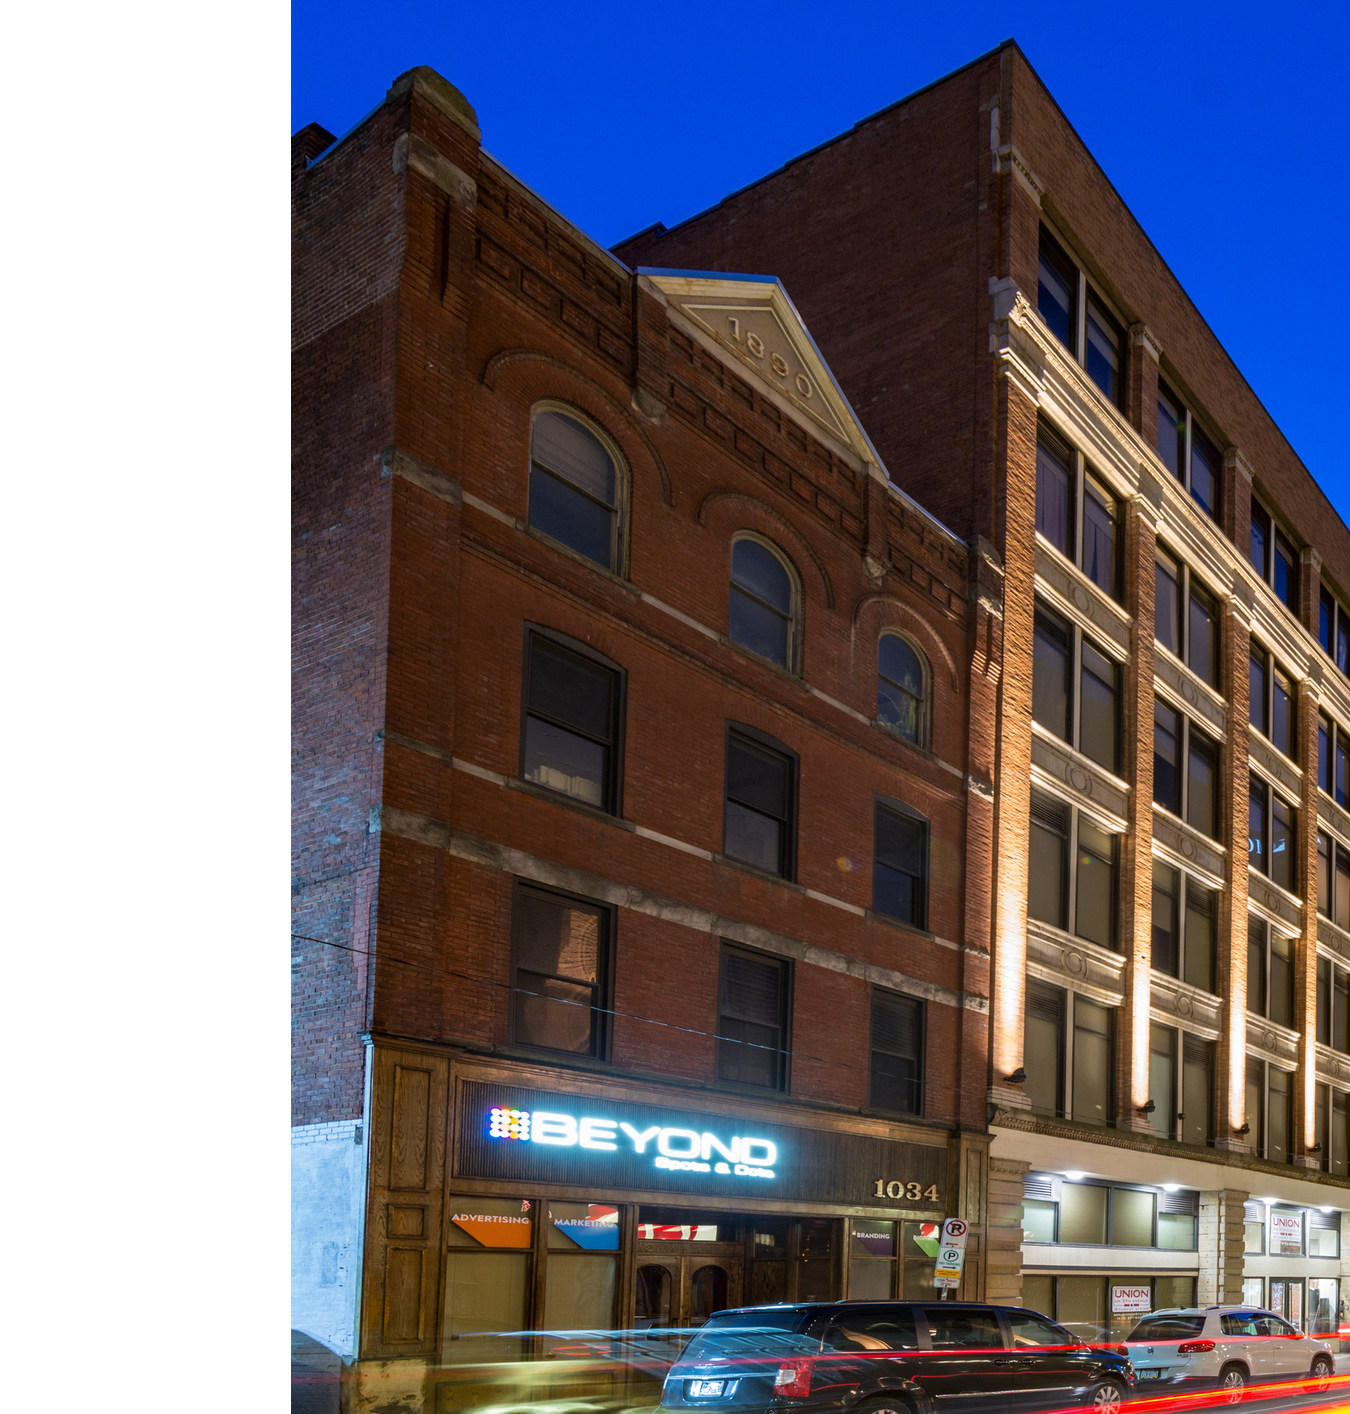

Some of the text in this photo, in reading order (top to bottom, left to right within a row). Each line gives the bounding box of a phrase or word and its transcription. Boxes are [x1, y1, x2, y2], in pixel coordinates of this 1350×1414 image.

[728, 316, 813, 398] 1890
[530, 1110, 778, 1167] BEYOND
[655, 1156, 775, 1178] Spots & Dots
[873, 1179, 939, 1201] 1034
[451, 1213, 530, 1224] ADVERTISING
[554, 1218, 614, 1228] MARKETING
[1273, 1217, 1300, 1228] UNION
[1115, 1289, 1149, 1298] UNION
